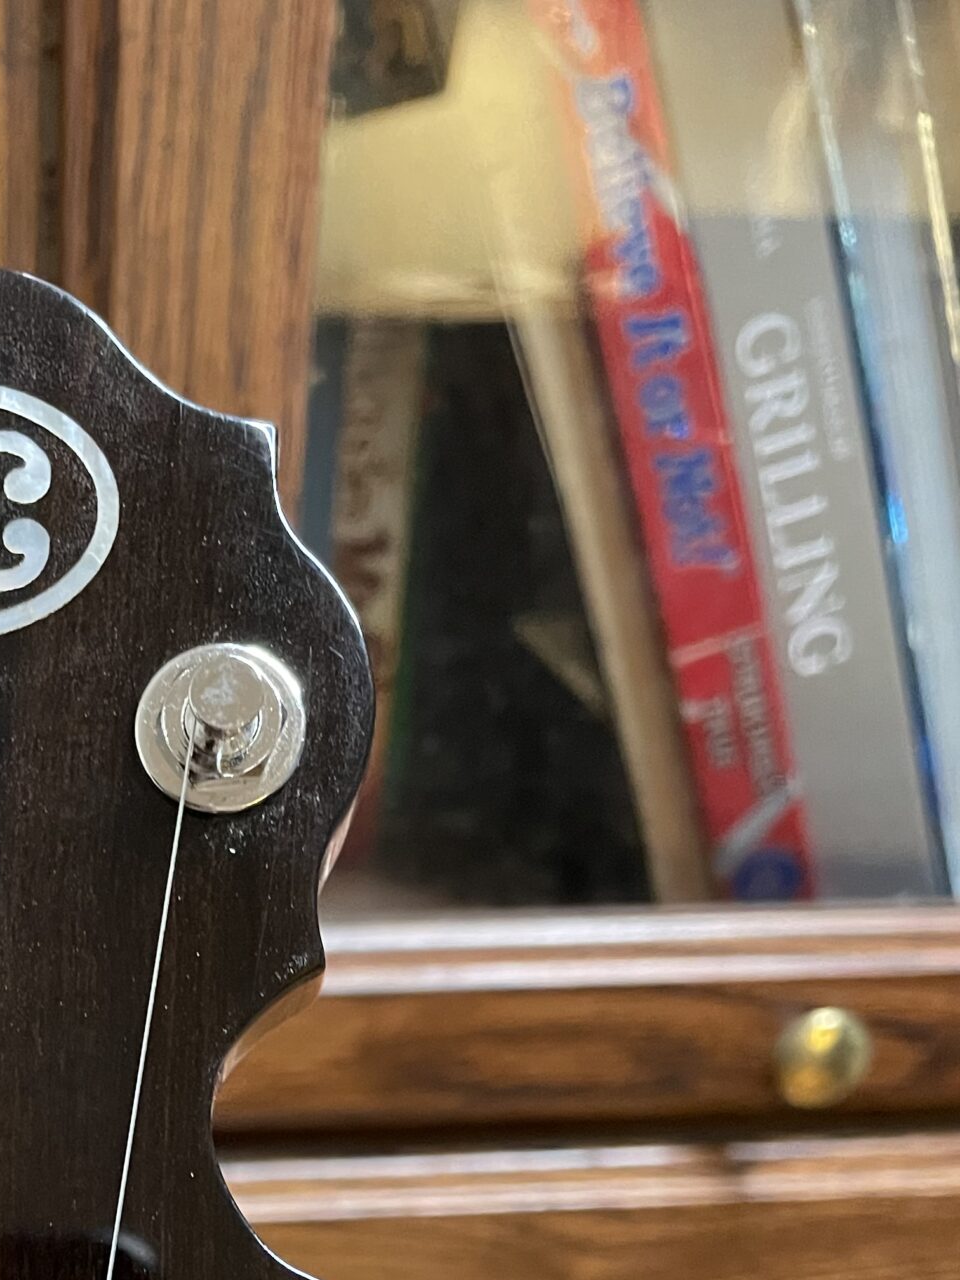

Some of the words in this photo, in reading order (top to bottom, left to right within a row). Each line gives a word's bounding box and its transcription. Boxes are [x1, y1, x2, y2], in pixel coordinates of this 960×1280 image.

[625, 313, 686, 368] It
[640, 376, 691, 438] or
[735, 312, 854, 677] GRILLING
